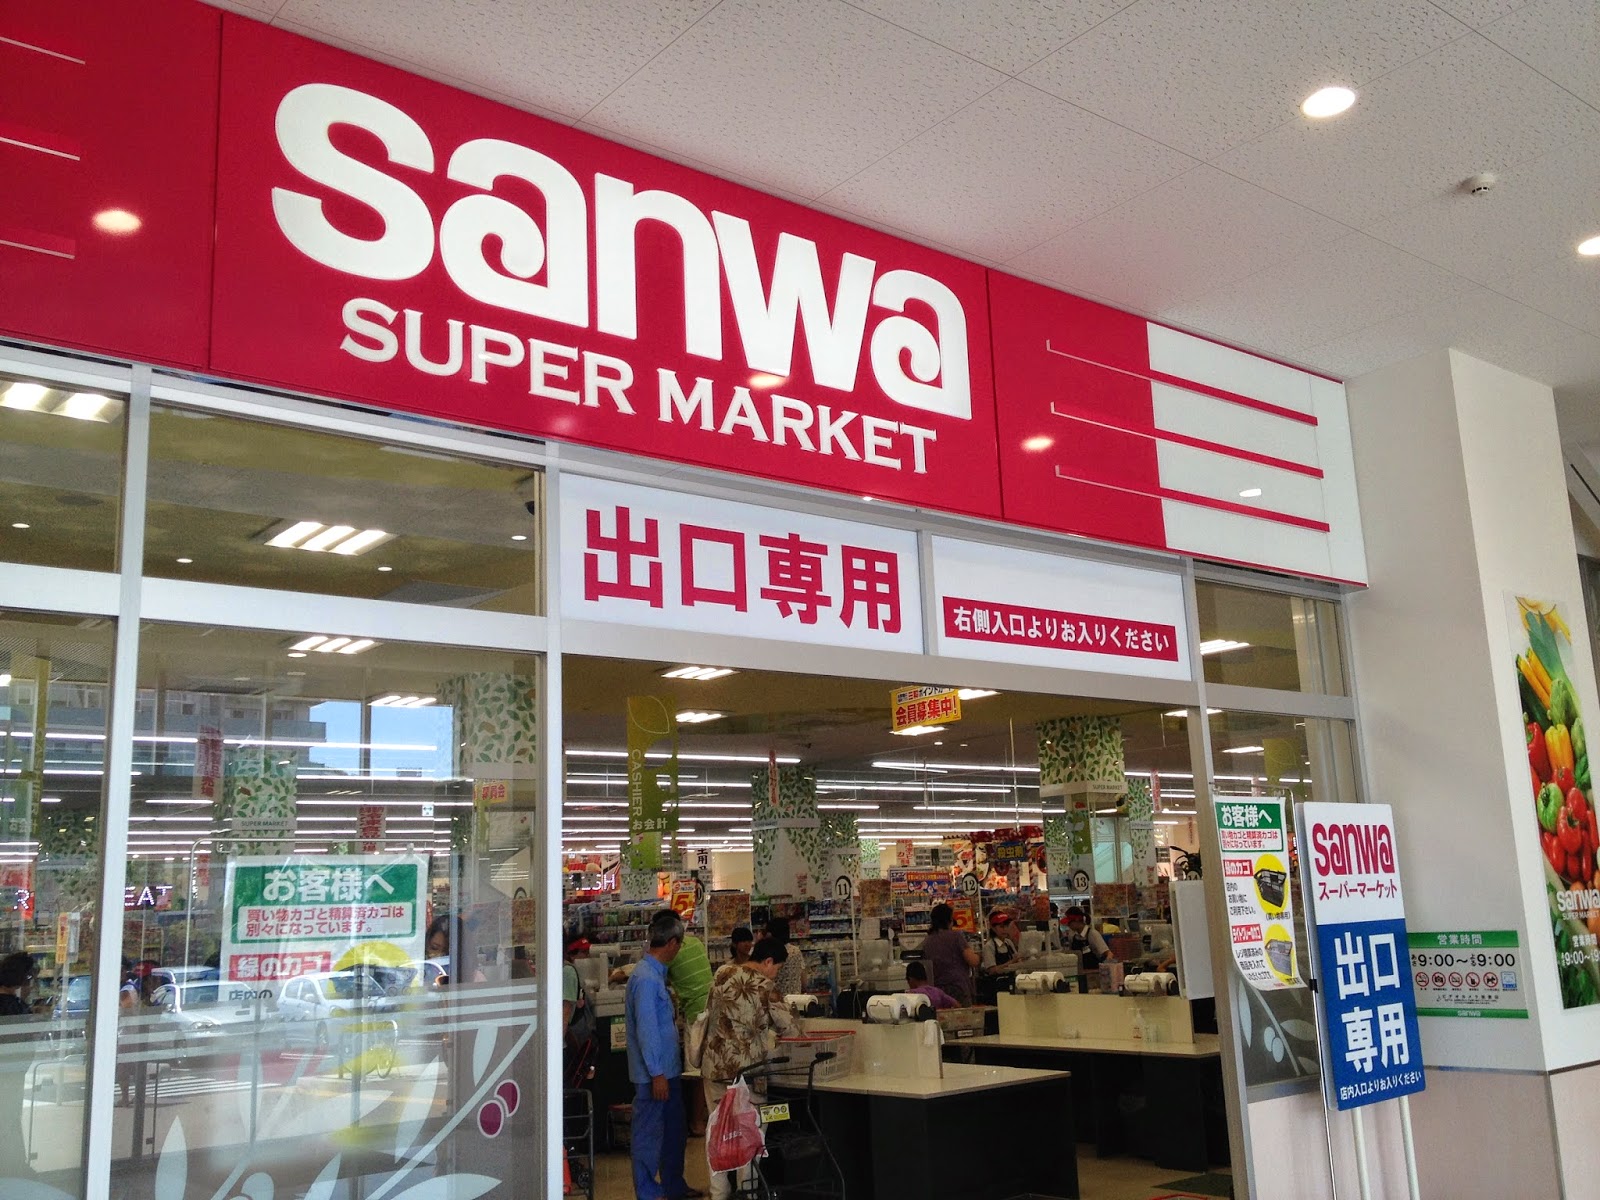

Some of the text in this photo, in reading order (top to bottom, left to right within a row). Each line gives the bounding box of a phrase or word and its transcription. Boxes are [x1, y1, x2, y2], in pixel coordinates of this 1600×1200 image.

[272, 83, 972, 420] sanwa
[340, 297, 937, 474] SUPER MARKET
[583, 505, 903, 634] 出口専用
[953, 606, 1171, 653] 右側入口よりお入りください
[631, 749, 643, 817] CASHIER
[631, 817, 668, 830] お会計
[1221, 805, 1272, 828] お客様へ
[1312, 823, 1395, 877] sanwa
[263, 867, 395, 902] お客様へ
[963, 880, 976, 891] 12
[1075, 877, 1087, 888] 13
[1318, 878, 1398, 901] スーパーマーケット
[1437, 934, 1482, 945] 営業時間
[1334, 931, 1401, 1000] 出口
[1341, 1001, 1410, 1074] 専用
[1339, 1070, 1422, 1101] 店内入口よりお入りください
